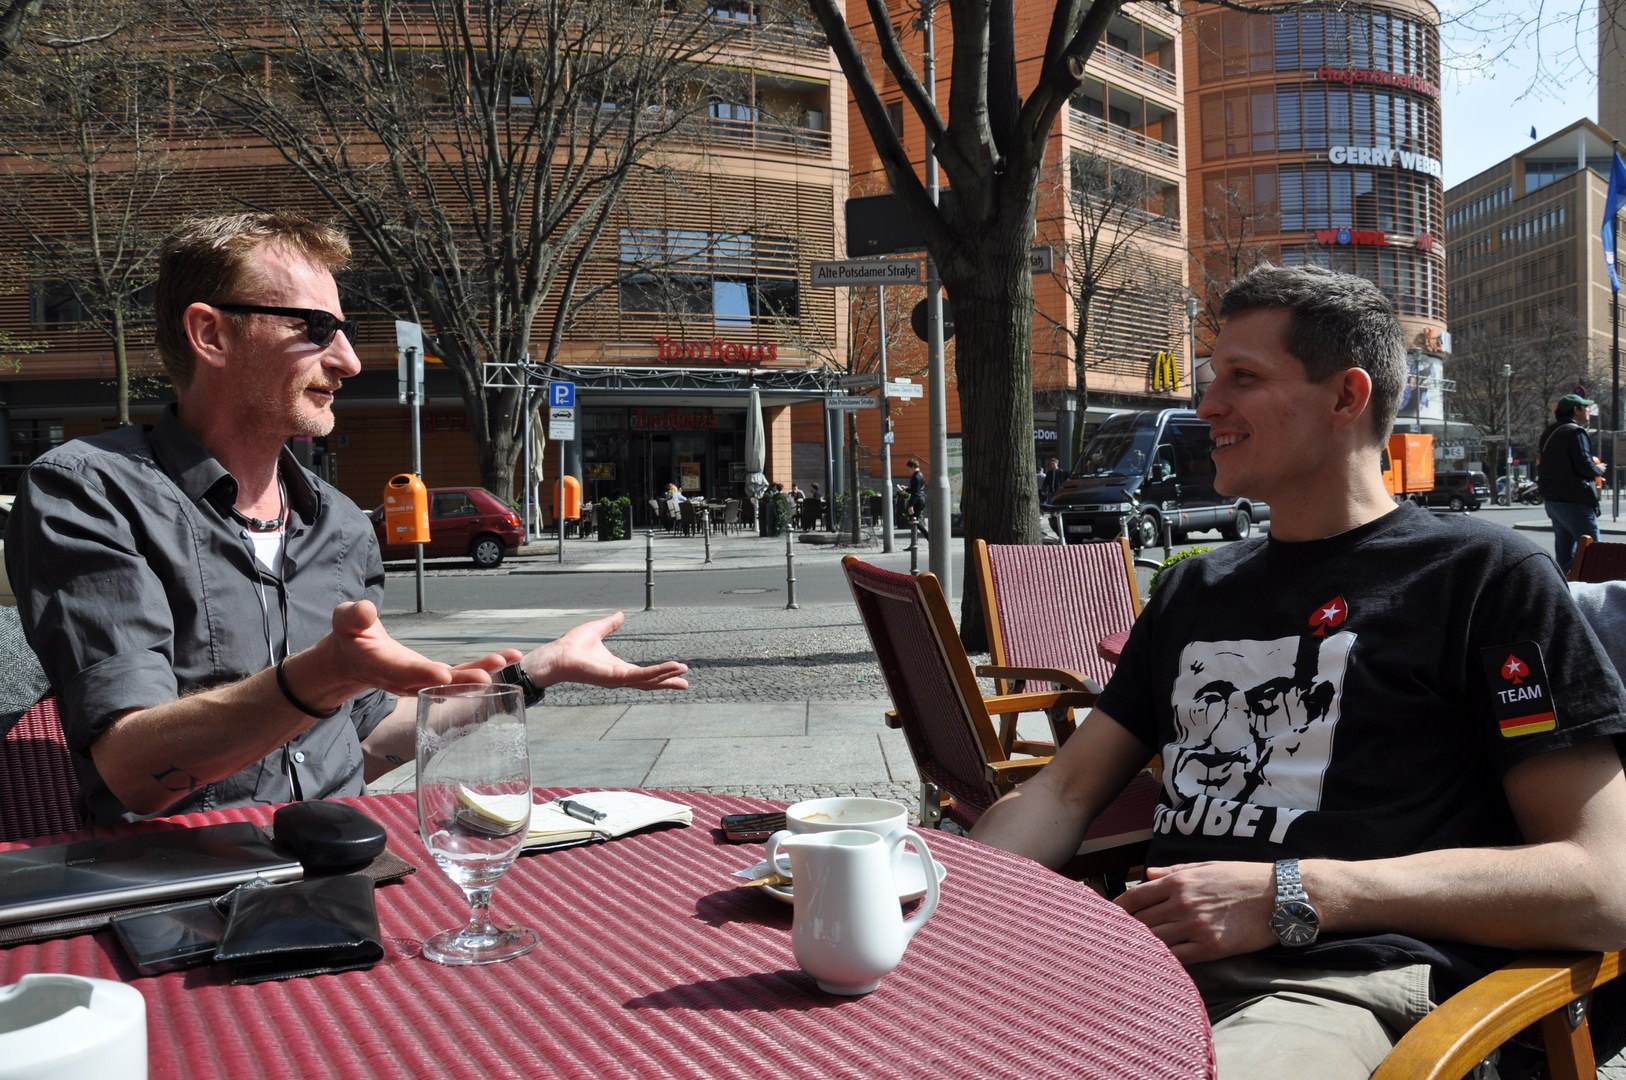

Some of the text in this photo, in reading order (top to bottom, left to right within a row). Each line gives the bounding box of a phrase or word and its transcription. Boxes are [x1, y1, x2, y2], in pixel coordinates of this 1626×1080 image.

[1328, 145, 1442, 180] GERRY WEBER
[818, 264, 916, 279] Alte Potsdamer Straße
[1497, 684, 1543, 704] TEAM
